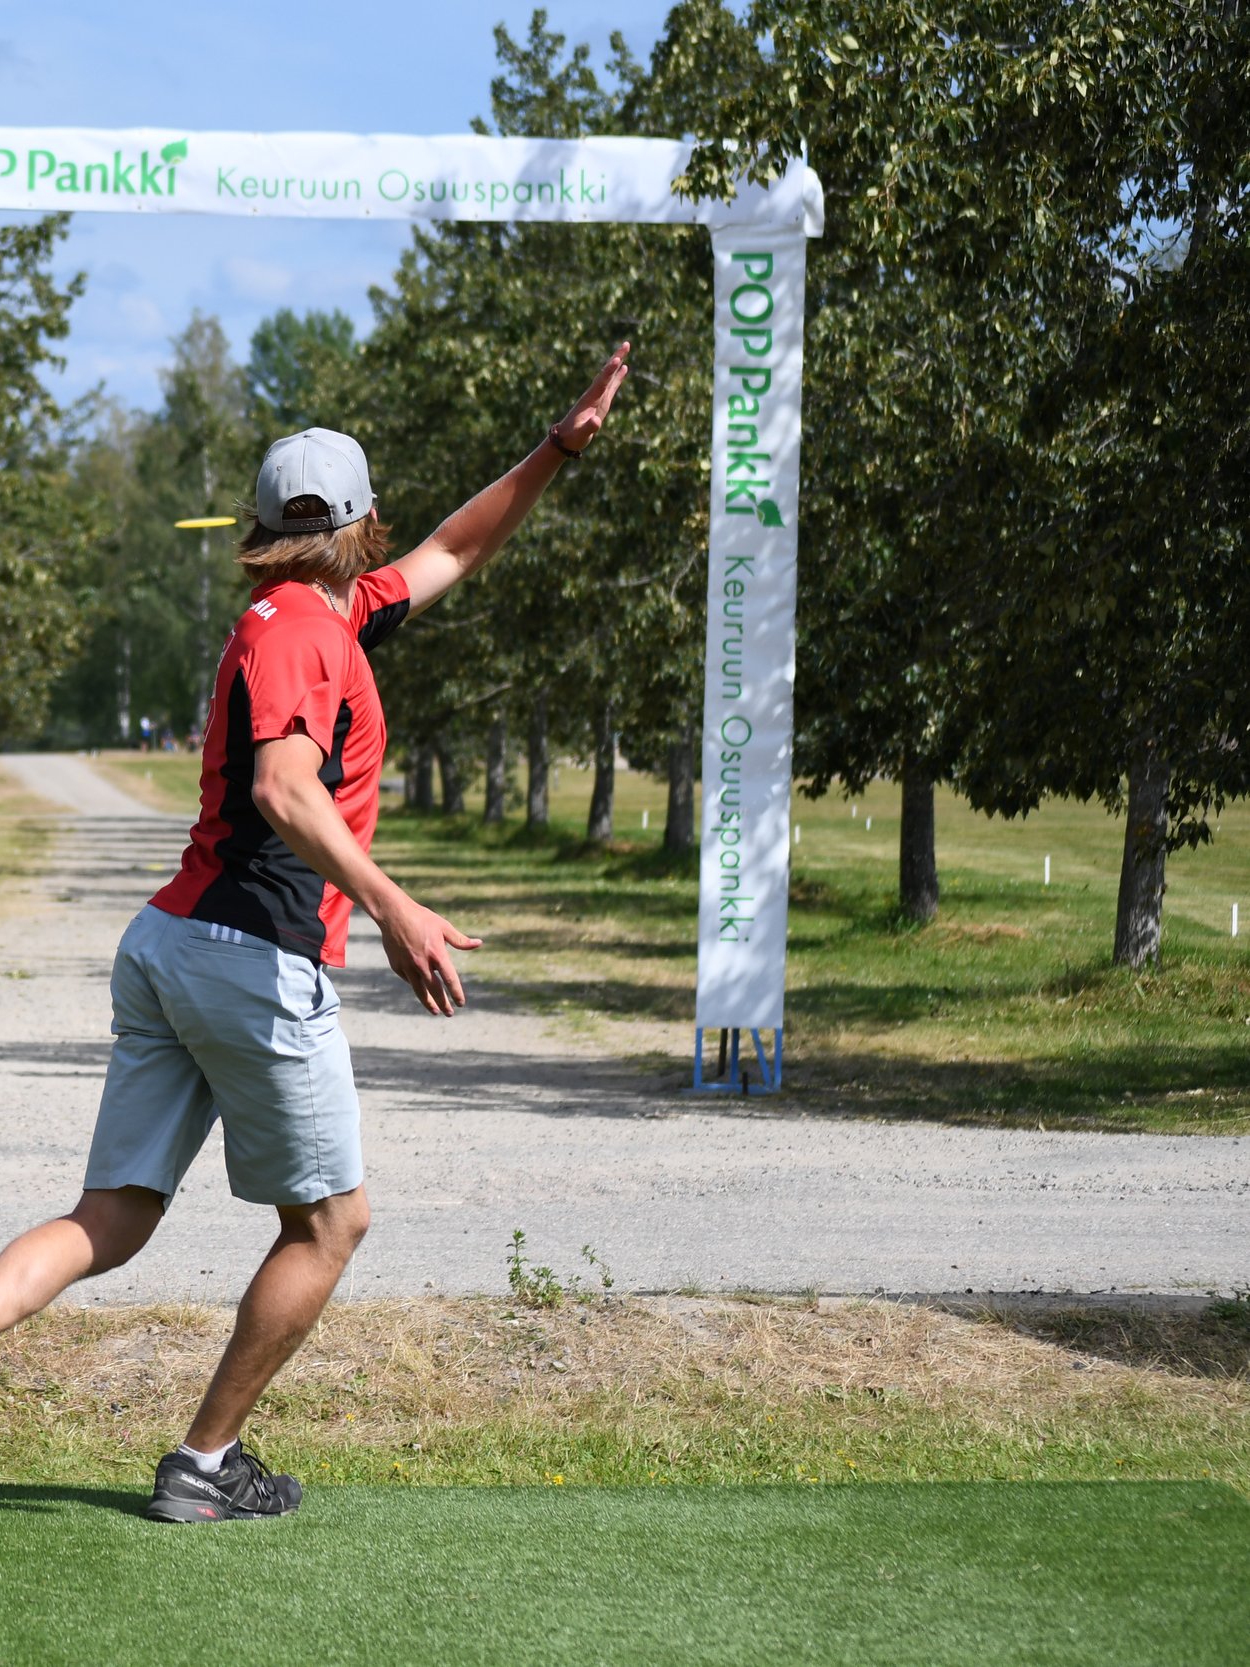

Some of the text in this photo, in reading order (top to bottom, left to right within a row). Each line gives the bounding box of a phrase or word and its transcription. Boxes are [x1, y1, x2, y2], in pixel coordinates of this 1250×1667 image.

[26, 146, 178, 197] Pankki
[217, 166, 362, 201] Keuruun
[376, 167, 607, 213] Osuuspankki
[711, 252, 775, 943] POP Pankki Keuruun Osuuspankki
